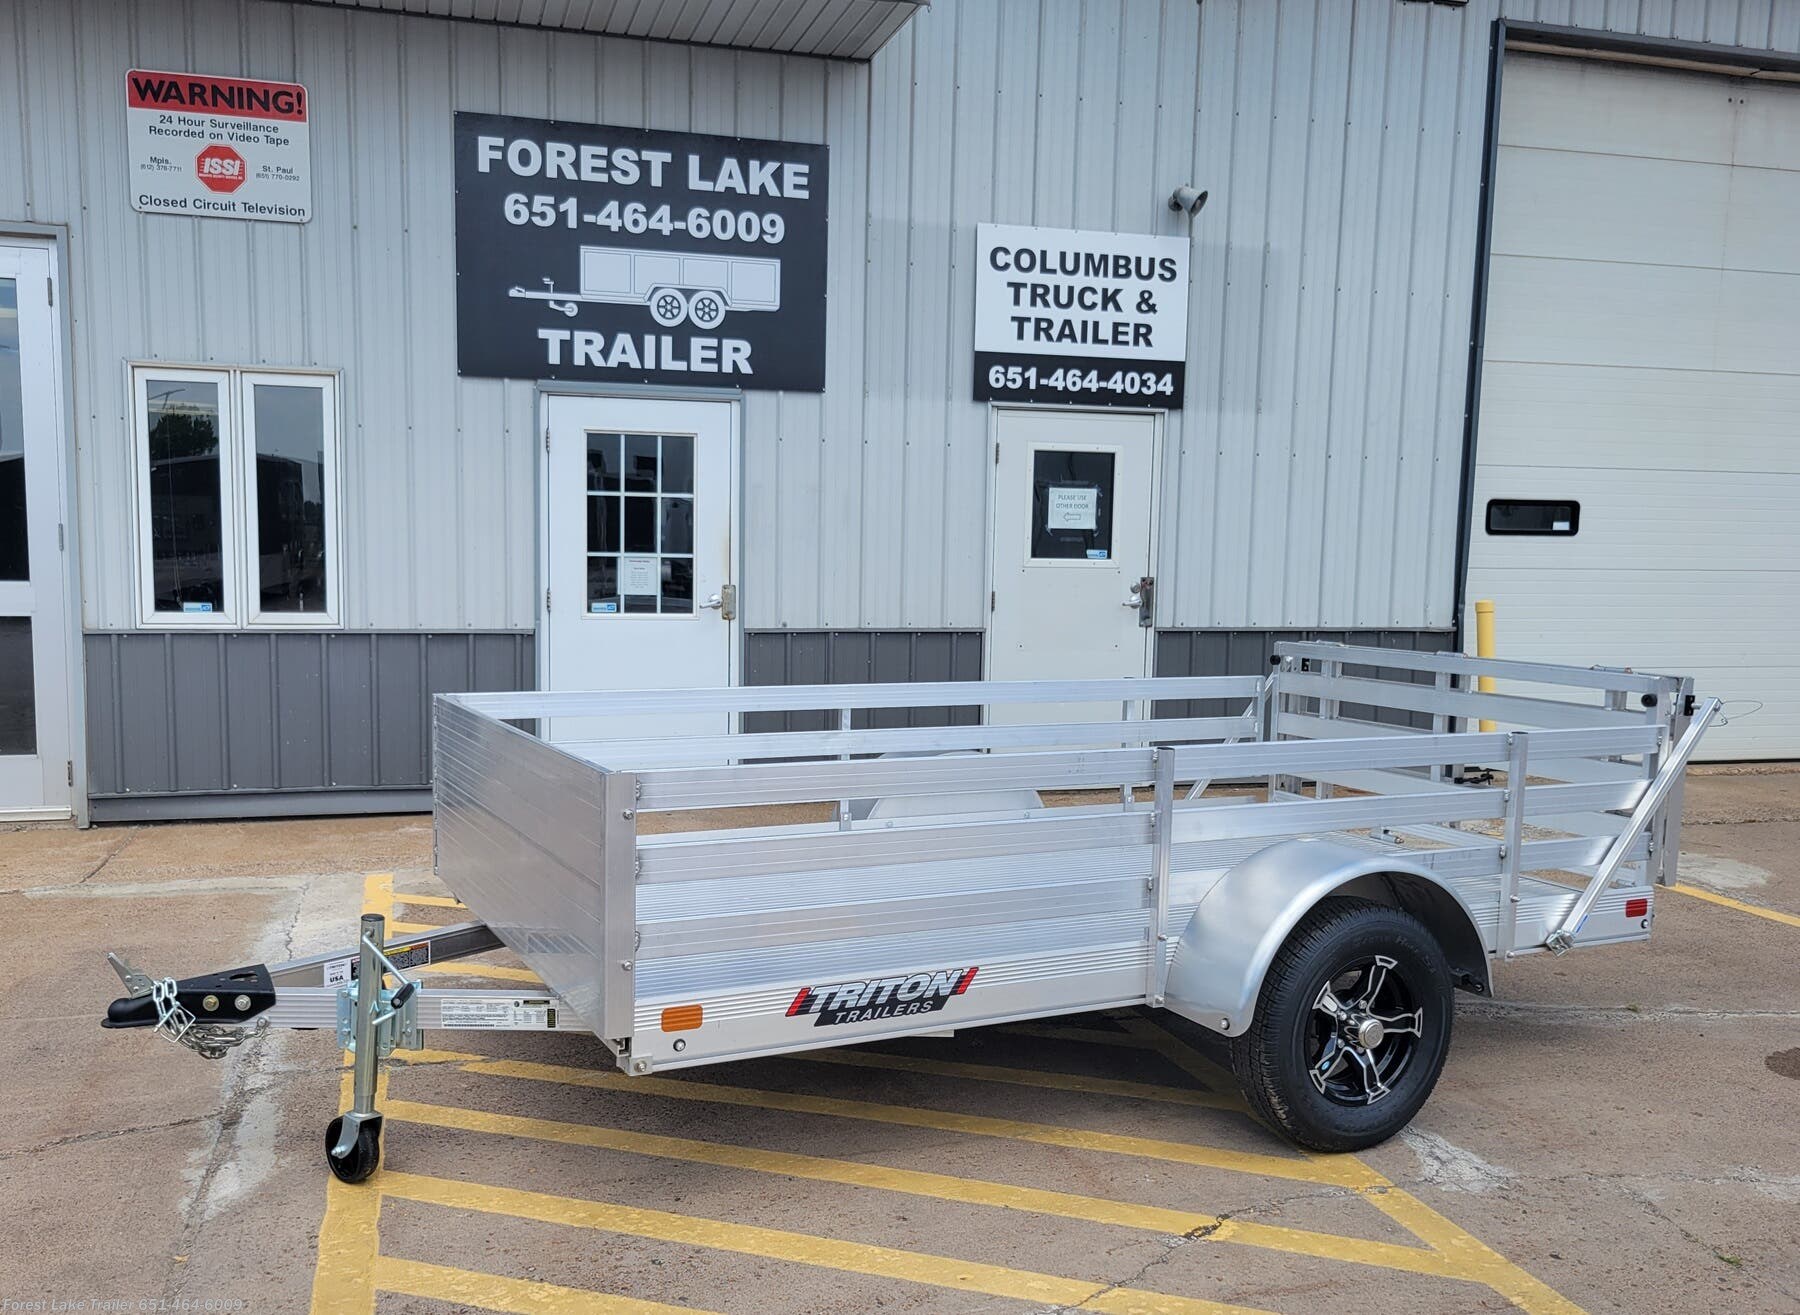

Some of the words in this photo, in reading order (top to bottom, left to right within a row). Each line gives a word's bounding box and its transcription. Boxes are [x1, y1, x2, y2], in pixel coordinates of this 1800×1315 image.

[132, 77, 303, 115] WARNING!
[149, 126, 205, 139] Recorded
[209, 131, 224, 140] on
[227, 132, 260, 144] Video
[264, 134, 290, 146] Tape
[159, 114, 173, 124] 24
[178, 116, 205, 128] Hour
[210, 118, 279, 134] Surveillance
[204, 157, 240, 176] ISSI
[477, 135, 672, 187] FOREST
[688, 154, 810, 200] LAKE
[139, 194, 188, 208] Closed
[193, 198, 237, 212] Circuit
[242, 202, 306, 216] Television
[504, 193, 785, 244] 651-464-6009
[989, 246, 1177, 282] COLUMBUS
[1006, 281, 1123, 313] TRUCK
[1135, 289, 1158, 314] &
[1010, 316, 1154, 348] TRAILER
[537, 328, 753, 375] TRAILER
[988, 365, 1174, 396] 651-464-4034
[809, 968, 963, 1013] TRITON
[834, 1000, 934, 1024] TRAILERS
